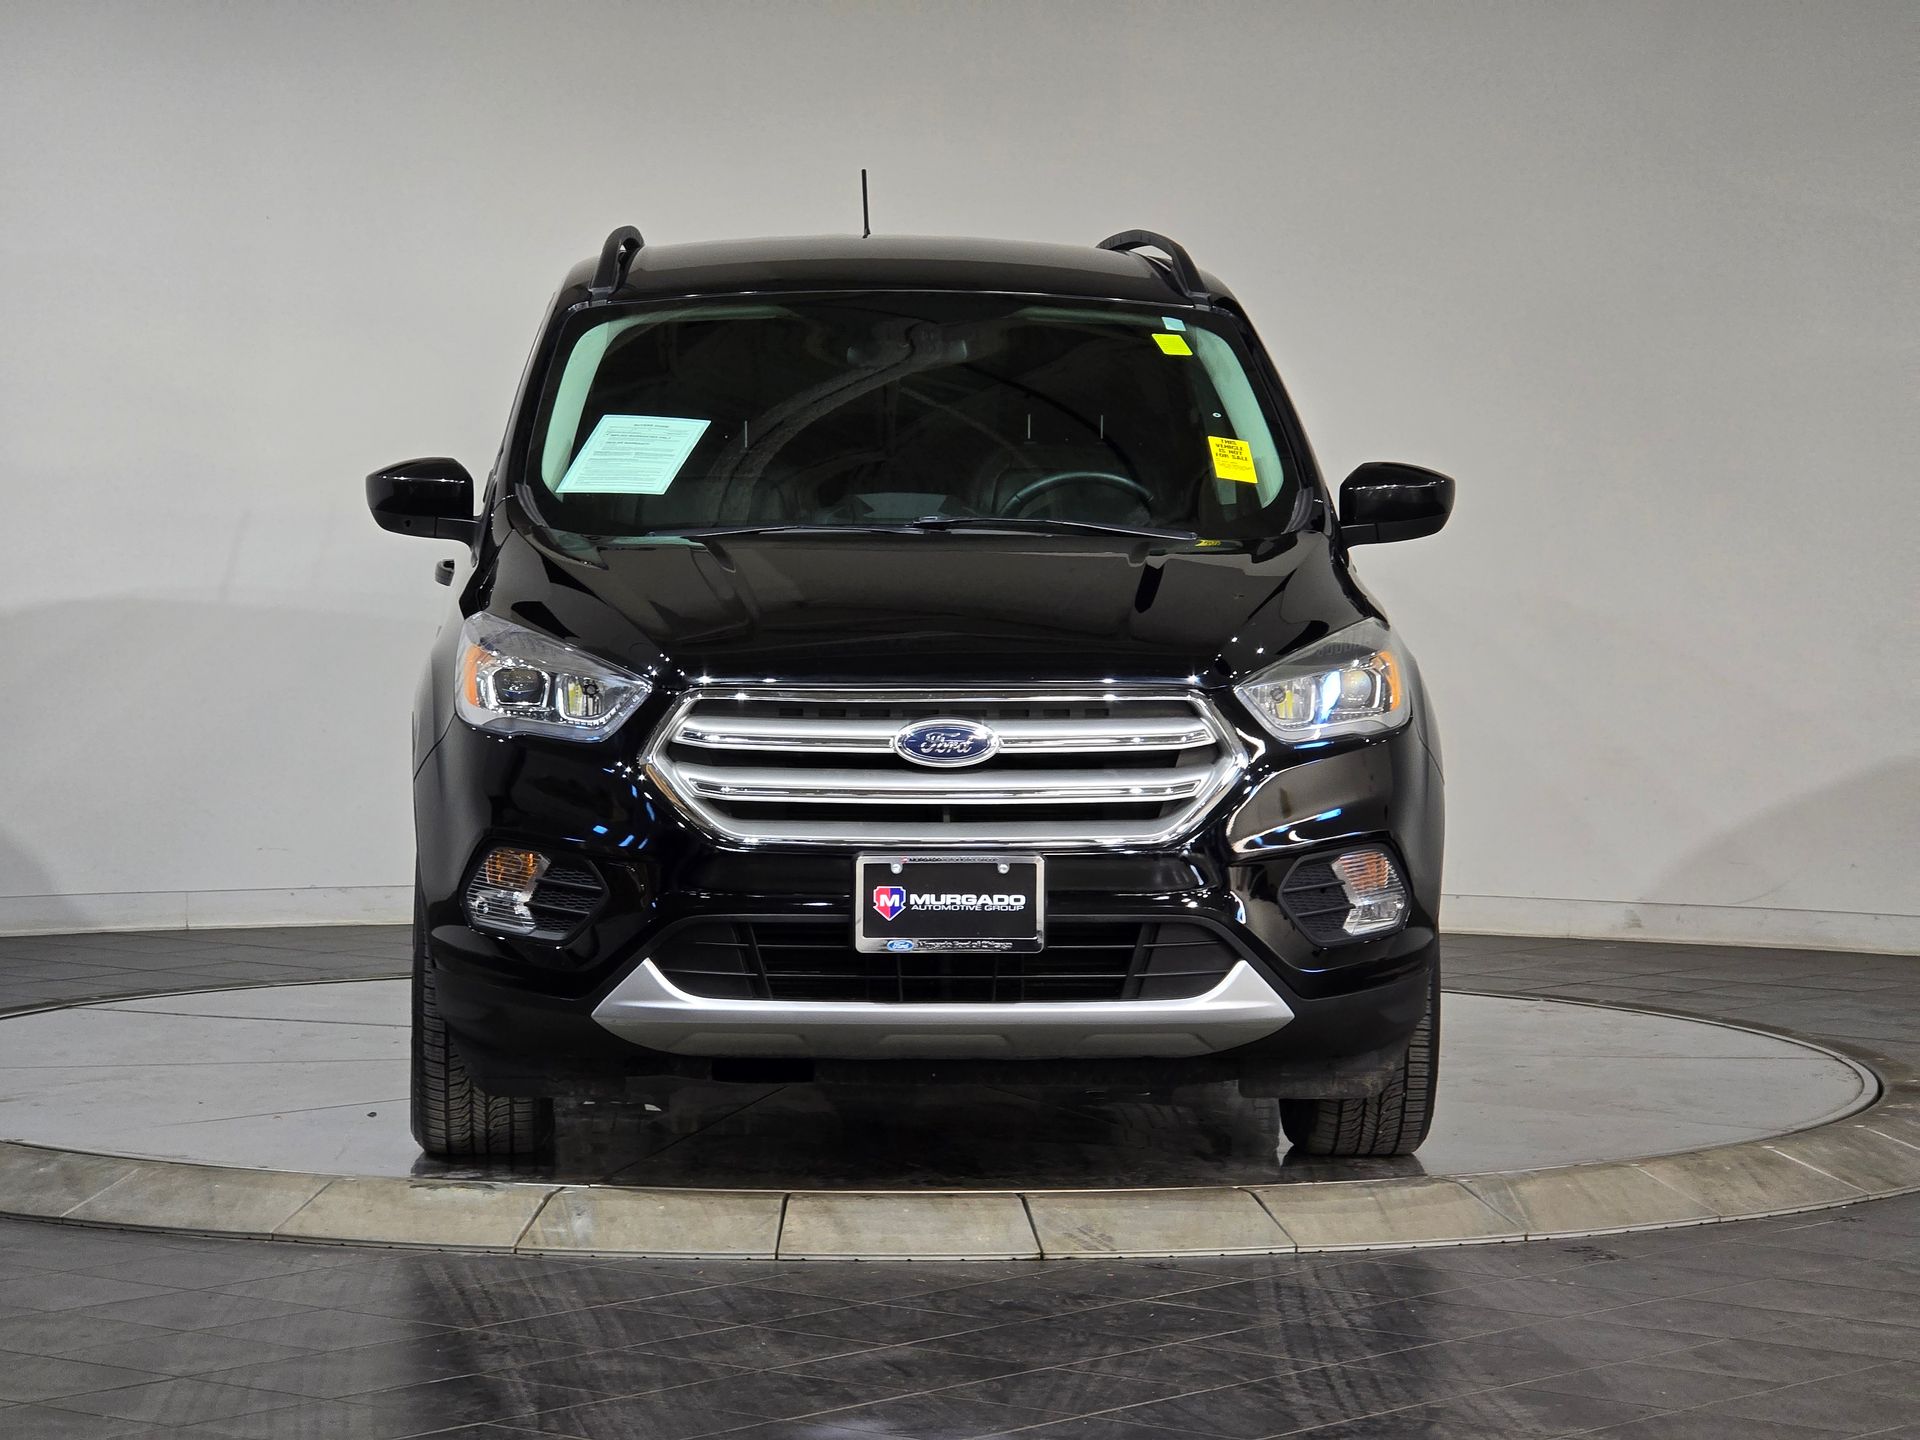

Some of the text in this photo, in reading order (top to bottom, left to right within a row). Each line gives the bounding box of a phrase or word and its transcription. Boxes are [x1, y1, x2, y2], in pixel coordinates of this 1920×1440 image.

[920, 731, 974, 753] Ford
[879, 894, 900, 907] M
[909, 893, 1026, 906] MURGADO
